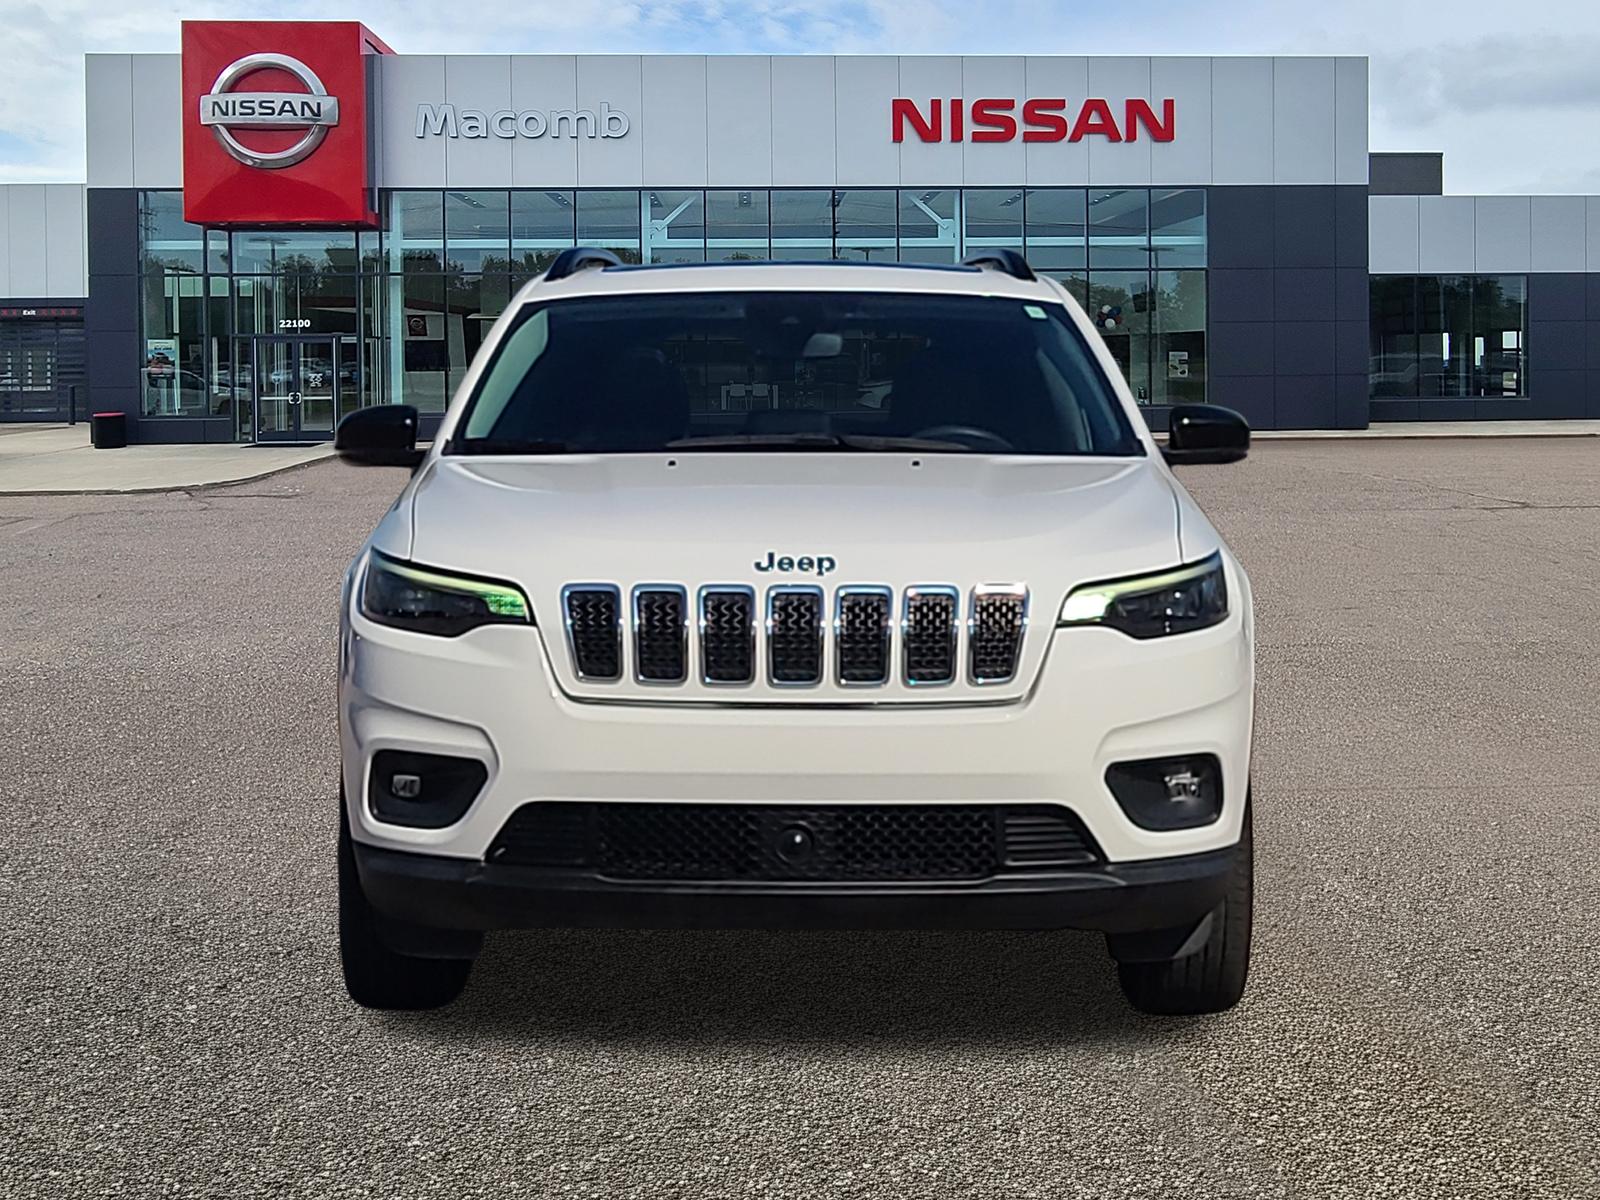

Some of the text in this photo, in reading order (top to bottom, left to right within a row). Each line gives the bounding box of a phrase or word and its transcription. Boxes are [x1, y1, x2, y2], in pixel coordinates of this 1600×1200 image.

[211, 100, 322, 118] NISSAN
[415, 102, 631, 139] Macomb
[892, 98, 1175, 143] NISSAN
[279, 319, 311, 328] 22100
[753, 551, 837, 577] Jeep
